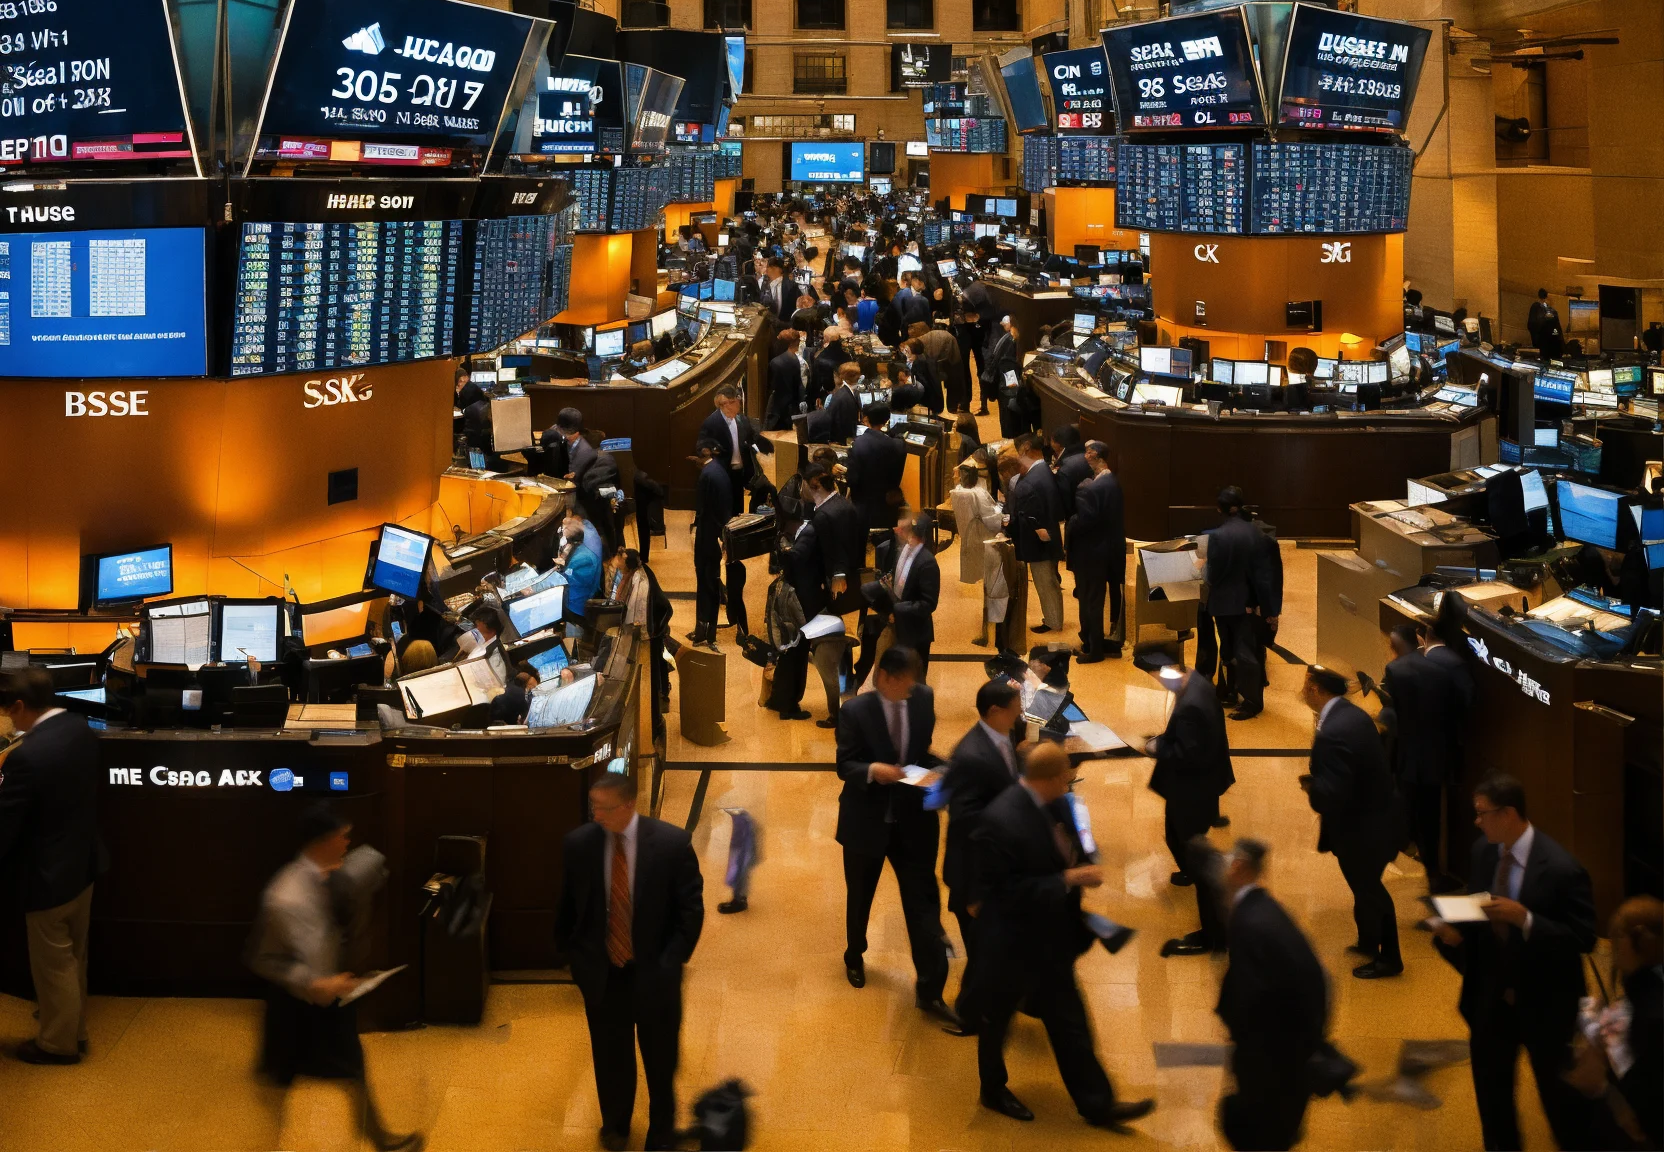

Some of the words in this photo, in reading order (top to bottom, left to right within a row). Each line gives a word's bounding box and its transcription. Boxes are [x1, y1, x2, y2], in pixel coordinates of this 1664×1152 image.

[331, 67, 402, 104] 305
[1194, 244, 1220, 264] CK
[65, 390, 149, 417] BSSE
